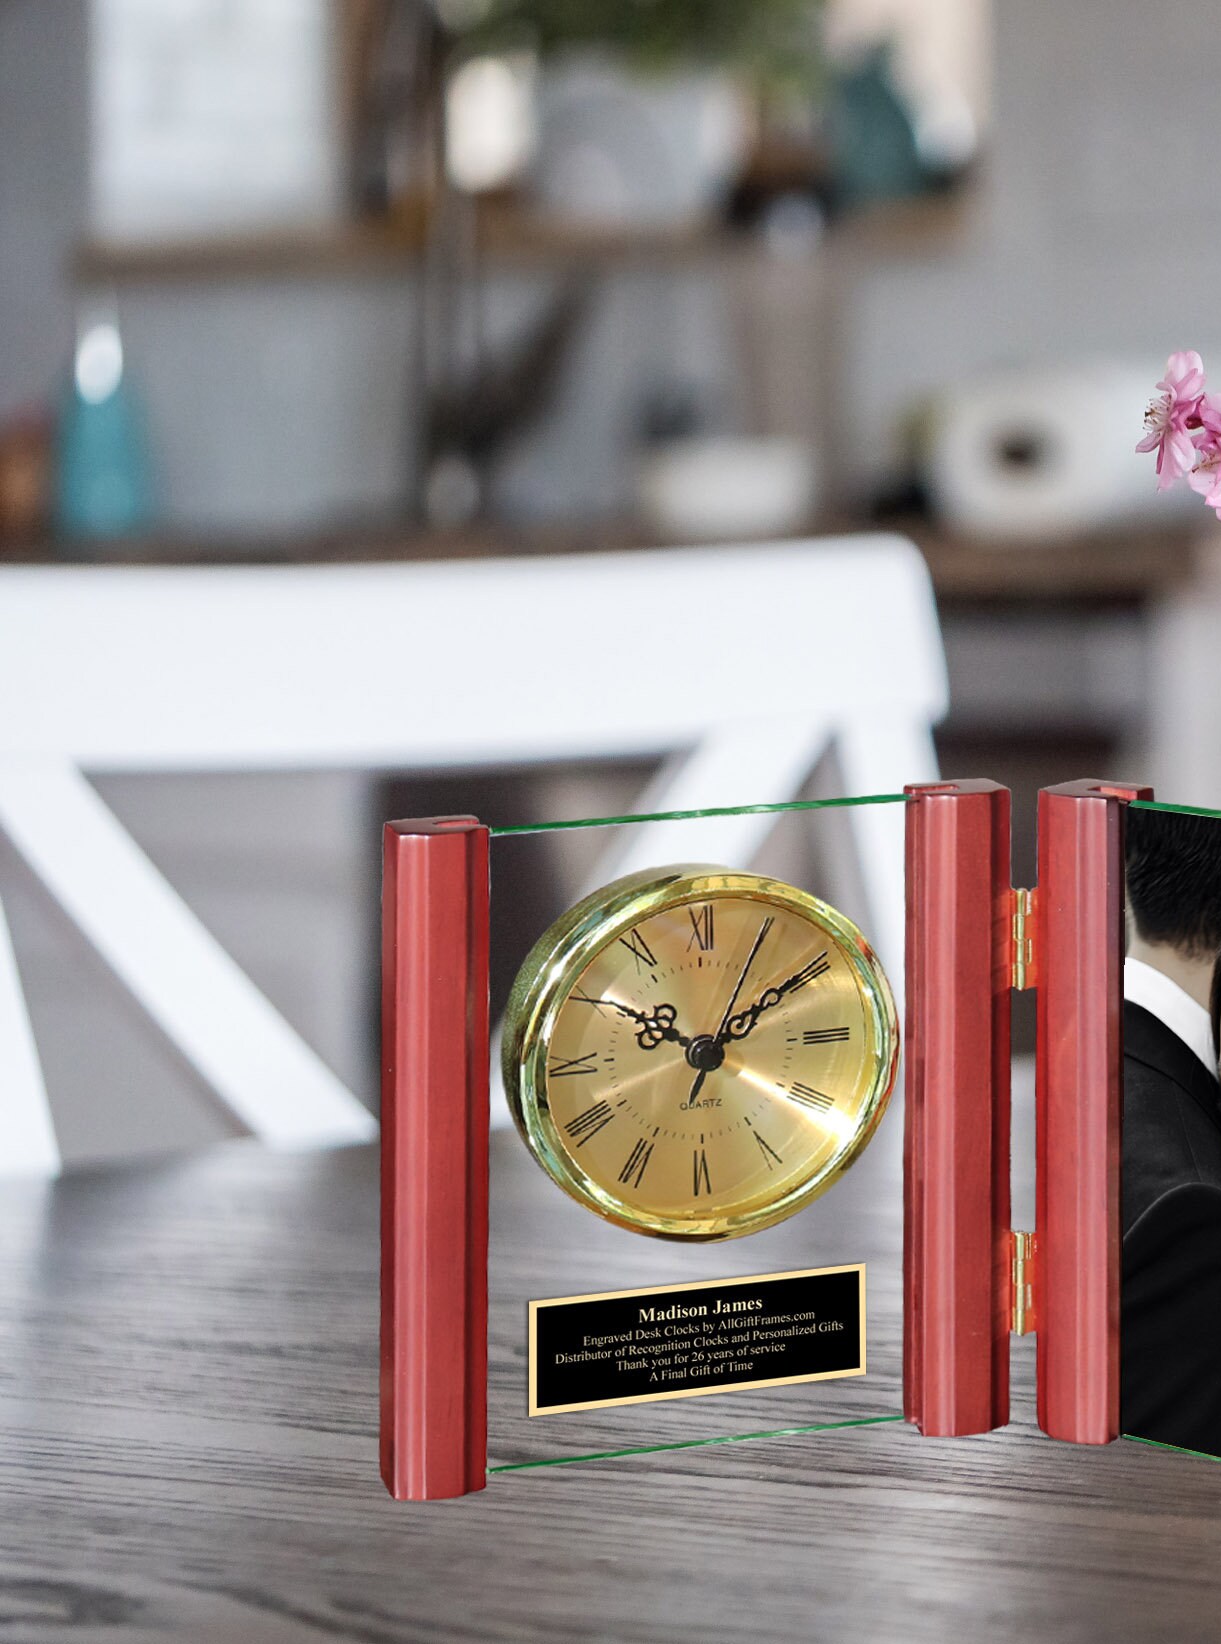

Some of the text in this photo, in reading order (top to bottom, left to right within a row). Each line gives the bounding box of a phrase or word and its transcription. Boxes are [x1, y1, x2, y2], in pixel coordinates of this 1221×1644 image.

[686, 904, 715, 953] XII
[618, 927, 659, 977] XI
[803, 1026, 851, 1046] III
[549, 1051, 598, 1078] IX
[679, 1097, 723, 1111] QUARTZ
[563, 1099, 617, 1149] VIII
[617, 1136, 656, 1190] VII
[752, 1129, 784, 1171] V
[692, 1148, 713, 1197] VI
[583, 1311, 816, 1347] Engraved Desk Clocks by AllGiftFrames.com
[638, 1298, 763, 1324] Madison James
[555, 1320, 845, 1365] Distributor of Recognition Clocks and Personalized Gifts
[616, 1342, 787, 1372] Thank you for 26 years of service
[649, 1360, 754, 1382] A Final Gift of Time
